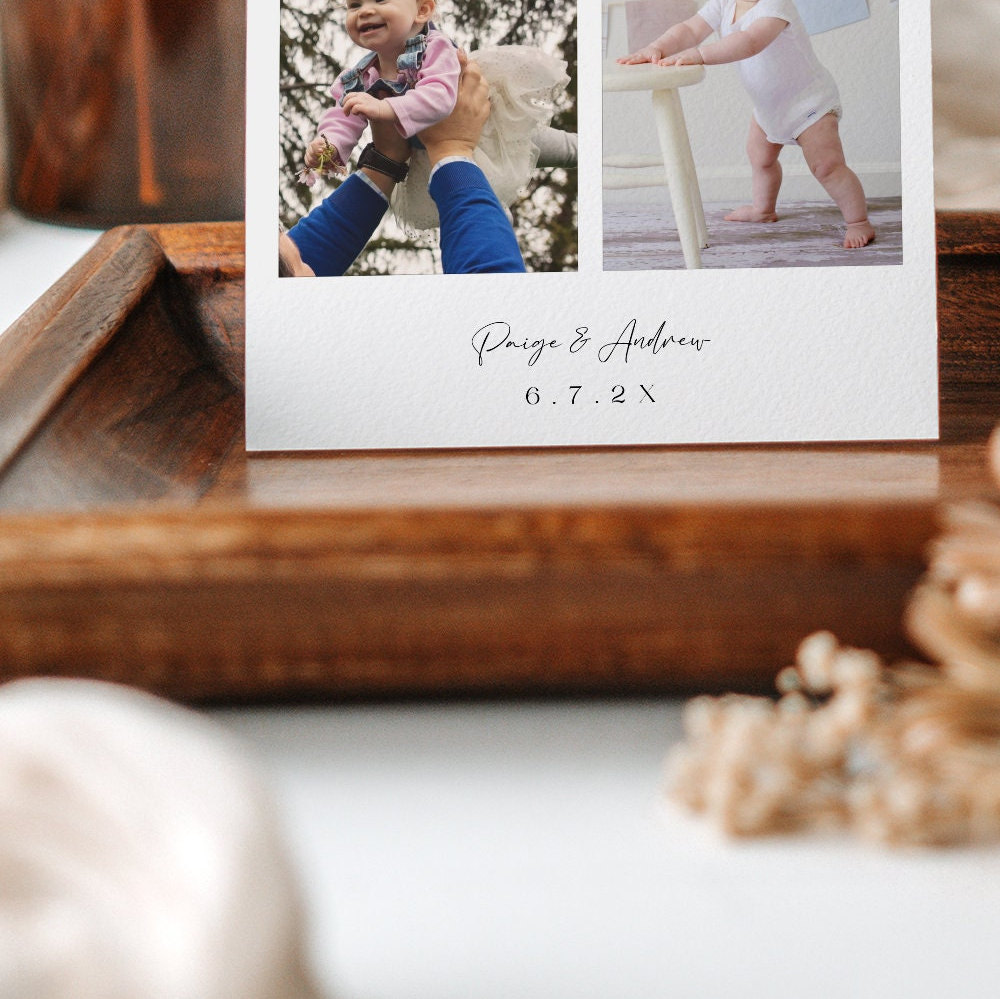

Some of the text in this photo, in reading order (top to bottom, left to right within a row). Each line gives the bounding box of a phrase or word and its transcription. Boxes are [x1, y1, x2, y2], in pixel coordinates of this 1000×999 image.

[471, 318, 712, 367] Paige & Andrew
